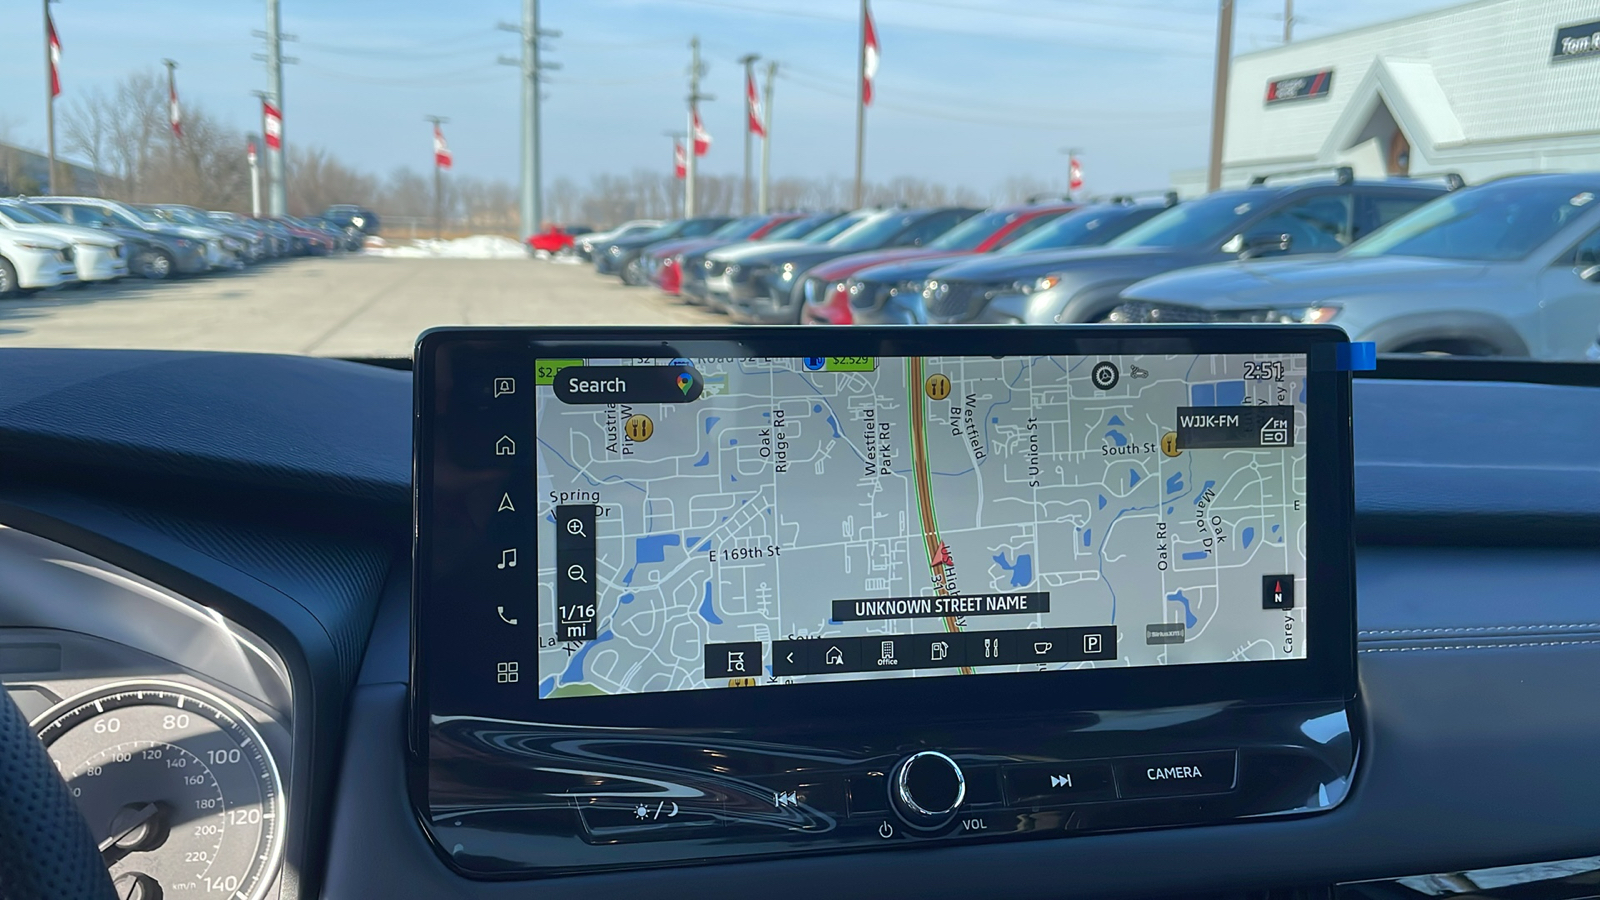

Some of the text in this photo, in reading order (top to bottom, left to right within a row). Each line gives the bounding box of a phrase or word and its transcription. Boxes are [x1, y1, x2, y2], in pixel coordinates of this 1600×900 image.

[1562, 36, 1590, 54] Tom
[833, 357, 868, 365] $2.529
[1244, 361, 1281, 380] 2:51
[569, 377, 626, 393] Search
[950, 407, 964, 436] Blvd
[964, 393, 987, 460] Westfield
[1180, 414, 1239, 428] WJJK-FM
[1273, 420, 1288, 428] FM
[758, 428, 771, 458] Oak
[773, 410, 789, 473] Ridge Rd
[863, 409, 876, 476] Westfield
[878, 422, 891, 475] Park Rd
[1101, 442, 1156, 456] South St
[1026, 417, 1040, 488] S Union St
[549, 489, 600, 504] Spring
[1196, 488, 1216, 554] Manor Dr
[1211, 515, 1227, 544] Oak
[709, 545, 780, 561] E 169th St
[1156, 522, 1168, 571] Oak Rd
[941, 546, 953, 563] US
[931, 575, 944, 590] 31
[1274, 593, 1283, 603] N
[559, 604, 596, 621] 1/16
[855, 596, 1027, 616] UNKNOWN STREET NAME
[567, 623, 587, 637] mi
[1283, 615, 1295, 653] Carey
[1088, 637, 1098, 651] P
[877, 658, 898, 666] Office
[94, 718, 121, 733] 60
[163, 714, 189, 729] 80
[112, 753, 132, 763] 100
[142, 750, 162, 760] 120
[207, 749, 241, 764] 100
[166, 758, 186, 768] 140
[87, 766, 102, 776] 80
[1147, 766, 1202, 781] CAMERA
[184, 775, 205, 785] 160
[195, 799, 215, 809] 180
[228, 809, 260, 825] 120
[963, 818, 987, 831] VOL
[195, 825, 216, 835] 200
[185, 851, 207, 861] 220
[172, 882, 196, 890] km/h
[204, 876, 237, 891] 140
